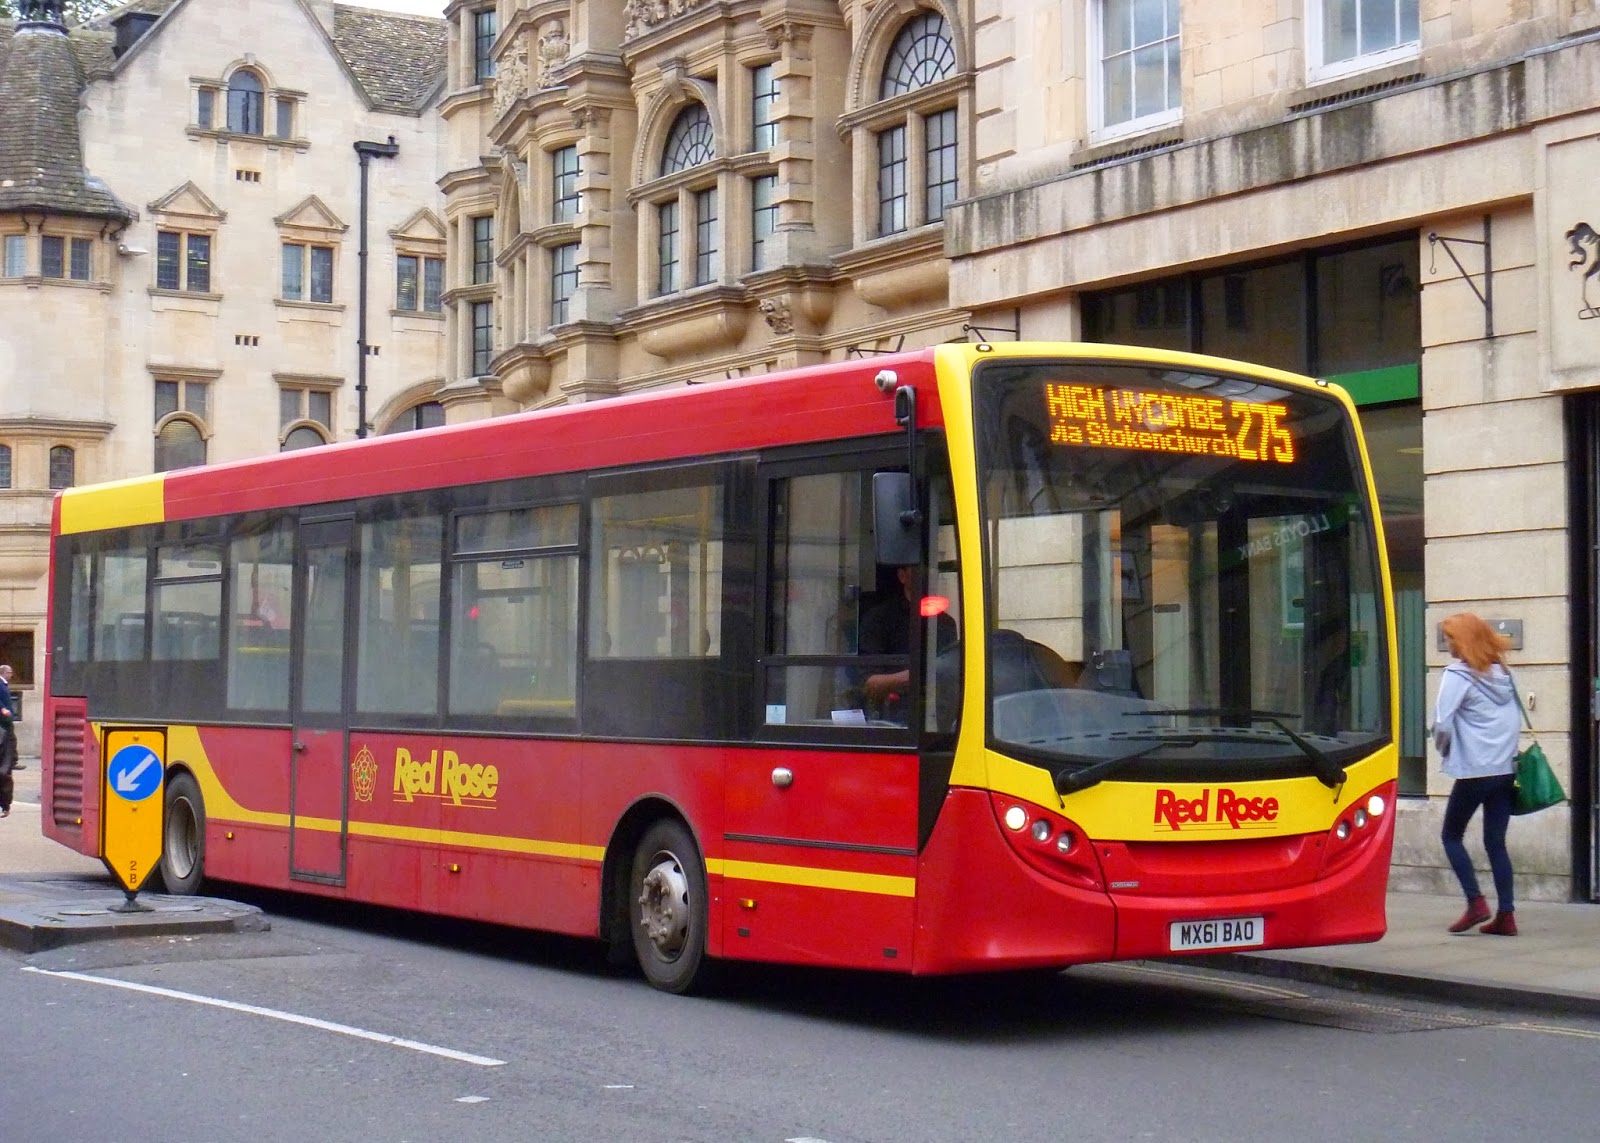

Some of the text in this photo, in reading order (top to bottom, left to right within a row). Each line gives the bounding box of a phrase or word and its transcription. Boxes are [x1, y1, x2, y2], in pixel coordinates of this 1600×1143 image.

[1046, 383, 1227, 431] HIGH WYCOMBE
[1050, 419, 1239, 456] via Stokenchurch
[1231, 402, 1295, 463] 275
[393, 747, 499, 806] Red Rose
[1153, 788, 1280, 831] Red Rose
[129, 860, 138, 871] 2
[129, 873, 138, 884] B
[1181, 923, 1218, 945] MX61
